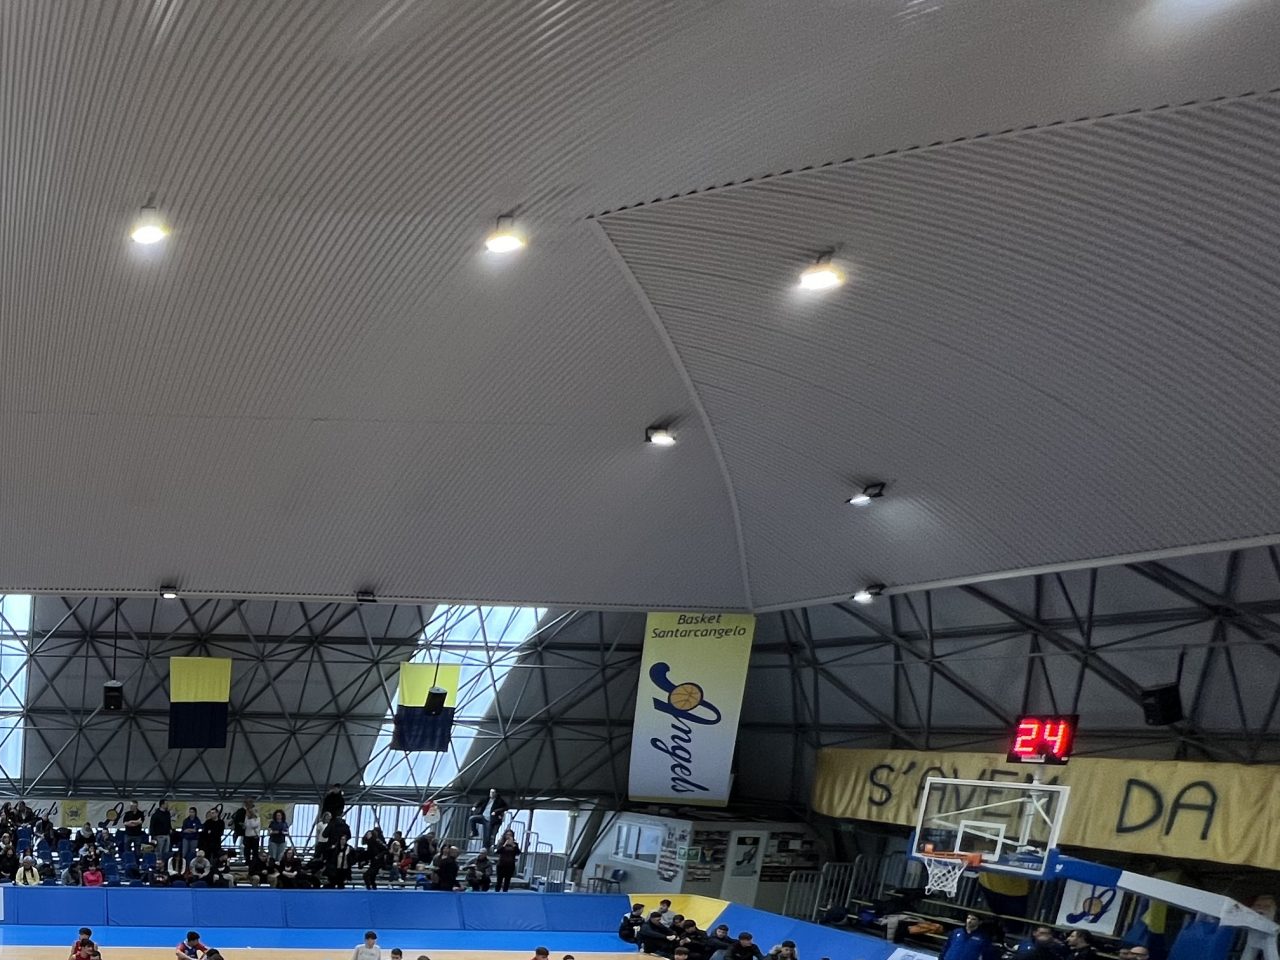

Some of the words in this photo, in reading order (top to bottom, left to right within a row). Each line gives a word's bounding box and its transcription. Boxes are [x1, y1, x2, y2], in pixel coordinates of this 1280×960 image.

[651, 626, 747, 639] Santarcangelo
[677, 614, 722, 625] Basket
[649, 662, 722, 793] Angels
[1014, 723, 1066, 754] 24
[1116, 778, 1217, 841] DA
